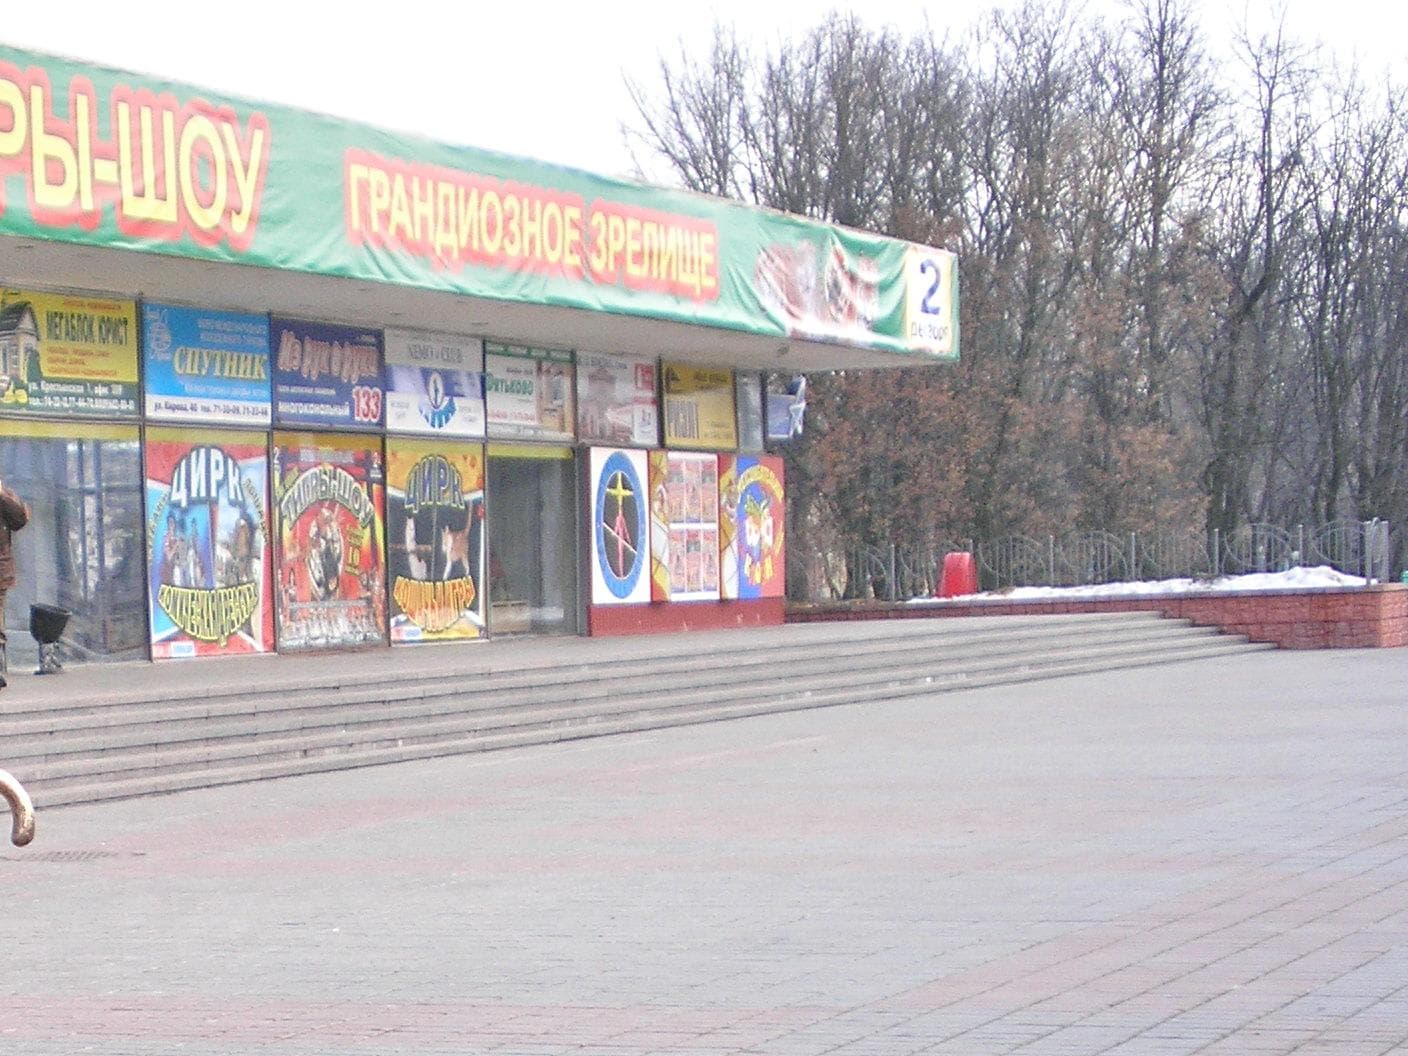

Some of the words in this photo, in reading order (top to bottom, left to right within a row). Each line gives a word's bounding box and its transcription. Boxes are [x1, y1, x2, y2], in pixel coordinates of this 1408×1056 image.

[349, 163, 583, 268] ГРАНДИОЗНОЕ
[591, 210, 717, 296] ЗРЕЛИЩЕ
[920, 258, 942, 316] 2
[173, 346, 268, 381] СПУТНИК
[352, 385, 382, 423] 133
[170, 447, 244, 509] ЦИРК
[404, 455, 466, 514] ЦИРК
